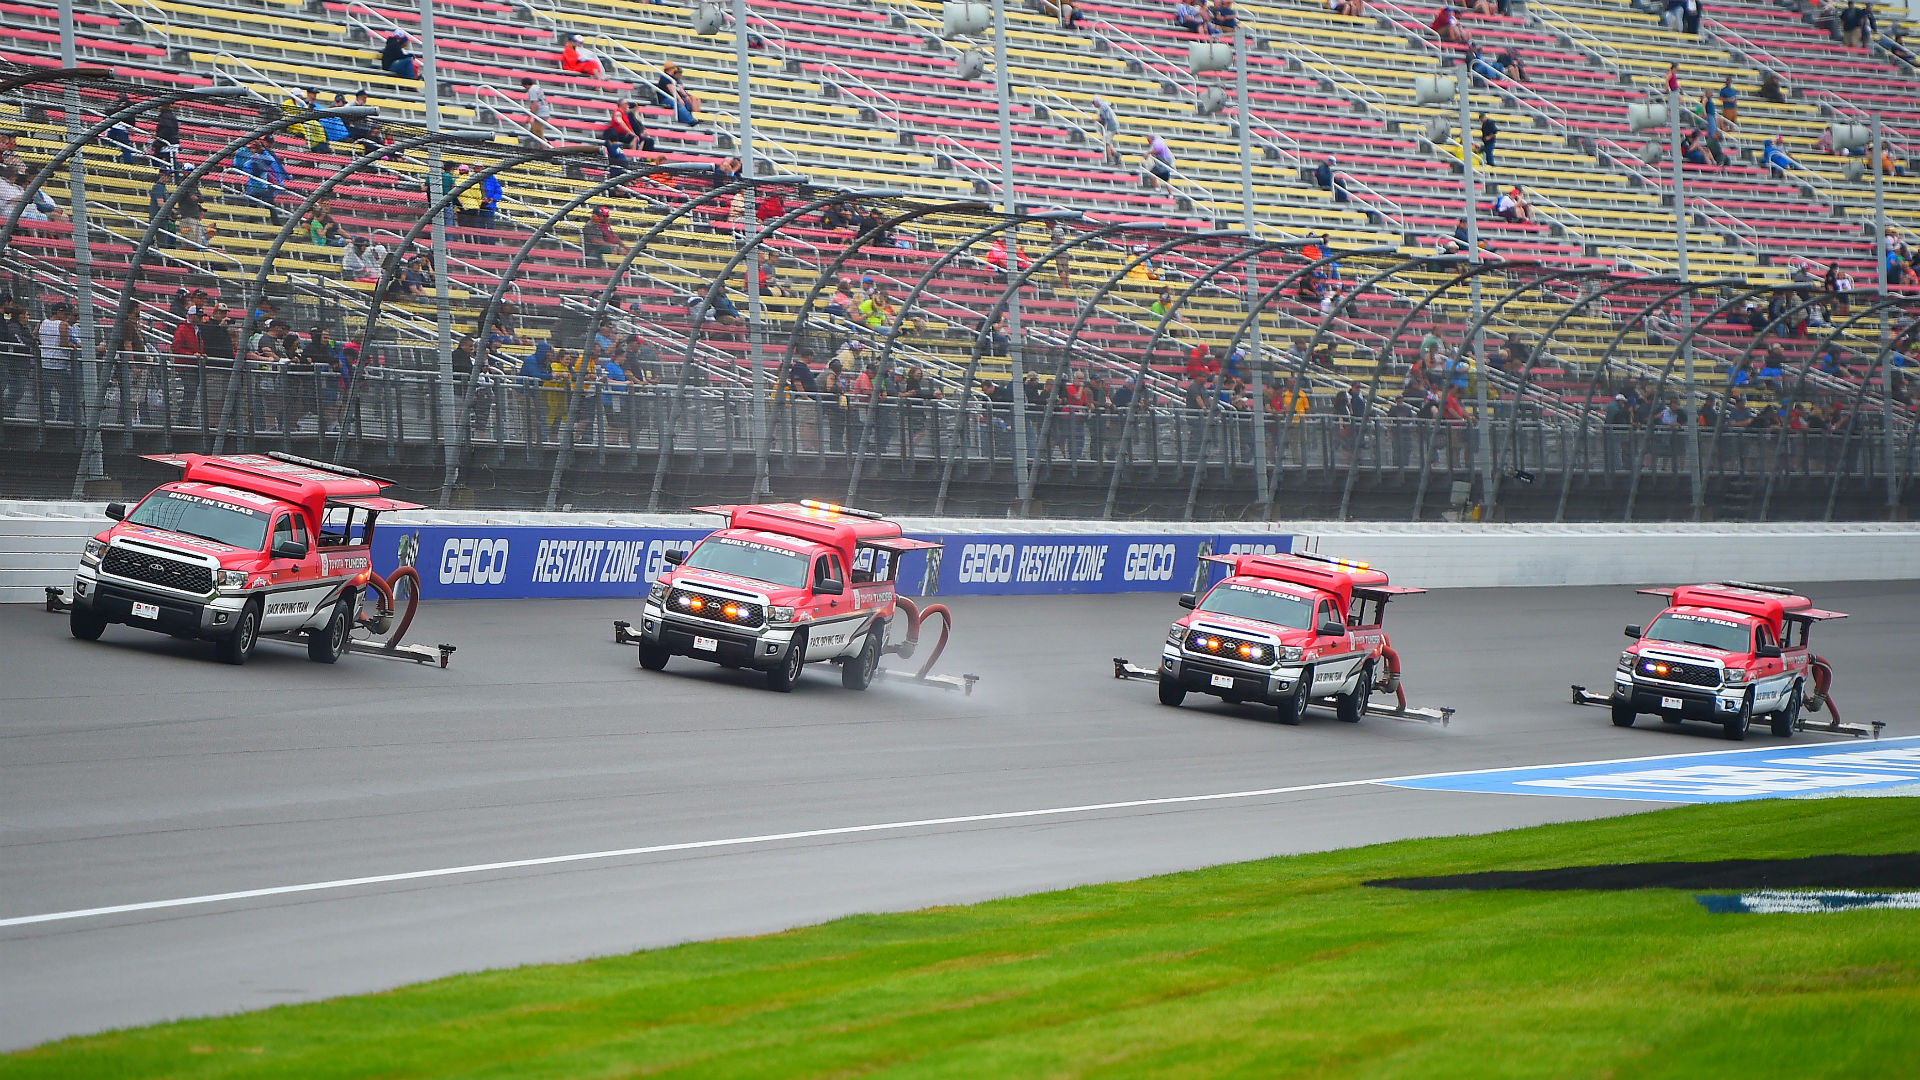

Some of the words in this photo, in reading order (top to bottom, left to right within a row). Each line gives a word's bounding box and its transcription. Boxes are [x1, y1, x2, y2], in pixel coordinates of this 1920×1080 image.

[168, 492, 201, 504] BUILT
[201, 498, 217, 507] IN
[217, 502, 254, 516] TEXAS
[439, 538, 509, 584] GEICO
[532, 540, 605, 582] RESTART
[600, 540, 645, 583] ZONE
[720, 537, 750, 547] BUILT
[749, 542, 762, 550] IN
[763, 545, 796, 557] TEXAS
[959, 543, 1015, 583] GEICO
[1016, 545, 1076, 582] RESTART
[1071, 545, 1109, 581] ZONE
[1123, 543, 1176, 581] GEICO
[1230, 584, 1257, 593] BUILT
[1270, 590, 1301, 602] TEXAS
[1671, 613, 1697, 621] BUILT
[1709, 618, 1738, 628] TEXAS
